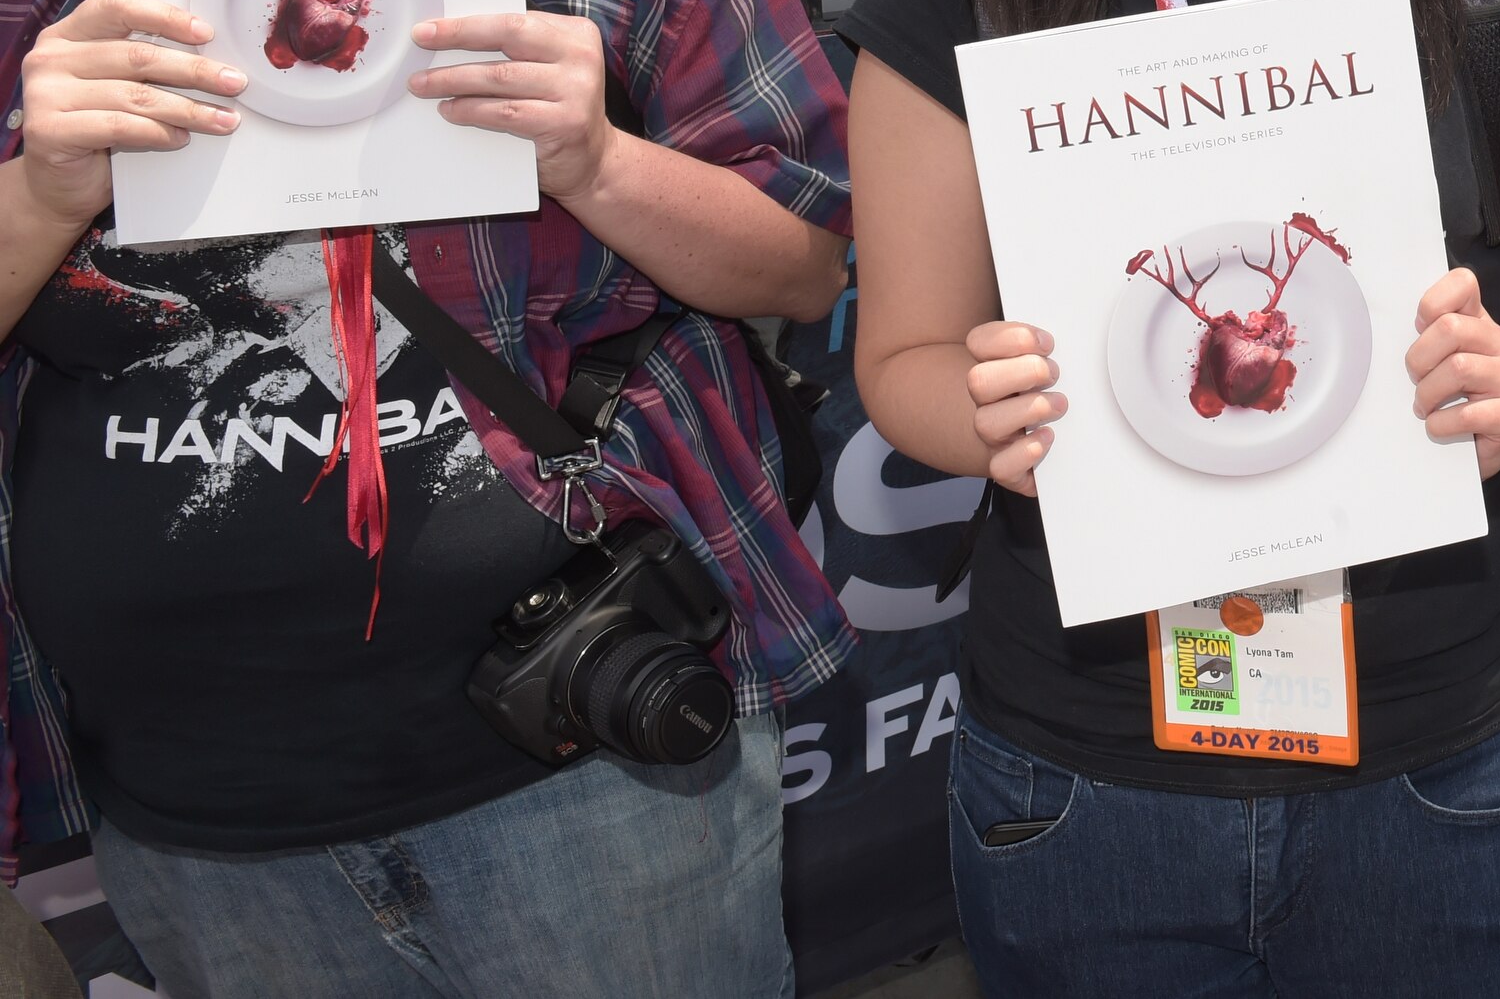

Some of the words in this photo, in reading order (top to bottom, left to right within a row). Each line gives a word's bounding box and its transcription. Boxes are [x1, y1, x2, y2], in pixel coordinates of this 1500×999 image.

[1118, 66, 1141, 78] THE
[1145, 61, 1167, 73] ART
[1173, 57, 1199, 69] AND
[1202, 48, 1249, 64] MAKING
[1252, 44, 1268, 55] OF
[1020, 52, 1374, 153] HANNIBAL
[1131, 151, 1156, 162] THE
[1162, 136, 1237, 157] TELEVISION
[1241, 127, 1284, 141] SERIES
[285, 192, 323, 204] JESSE
[328, 188, 378, 200] McLEAN
[105, 386, 471, 473] HANNBA
[1228, 545, 1266, 562] JESSE
[1271, 533, 1323, 552] McLEAN
[1195, 638, 1230, 657] CON
[1200, 632, 1230, 640] DIEGO
[1177, 637, 1198, 688] COMIC
[1246, 647, 1272, 658] Lyona
[1275, 648, 1294, 658] Tam
[1249, 668, 1262, 678] CA
[1190, 699, 1224, 712] 2015
[679, 704, 713, 734] Canon
[1191, 731, 1262, 750] 4-DAY
[1268, 735, 1320, 755] 2015
